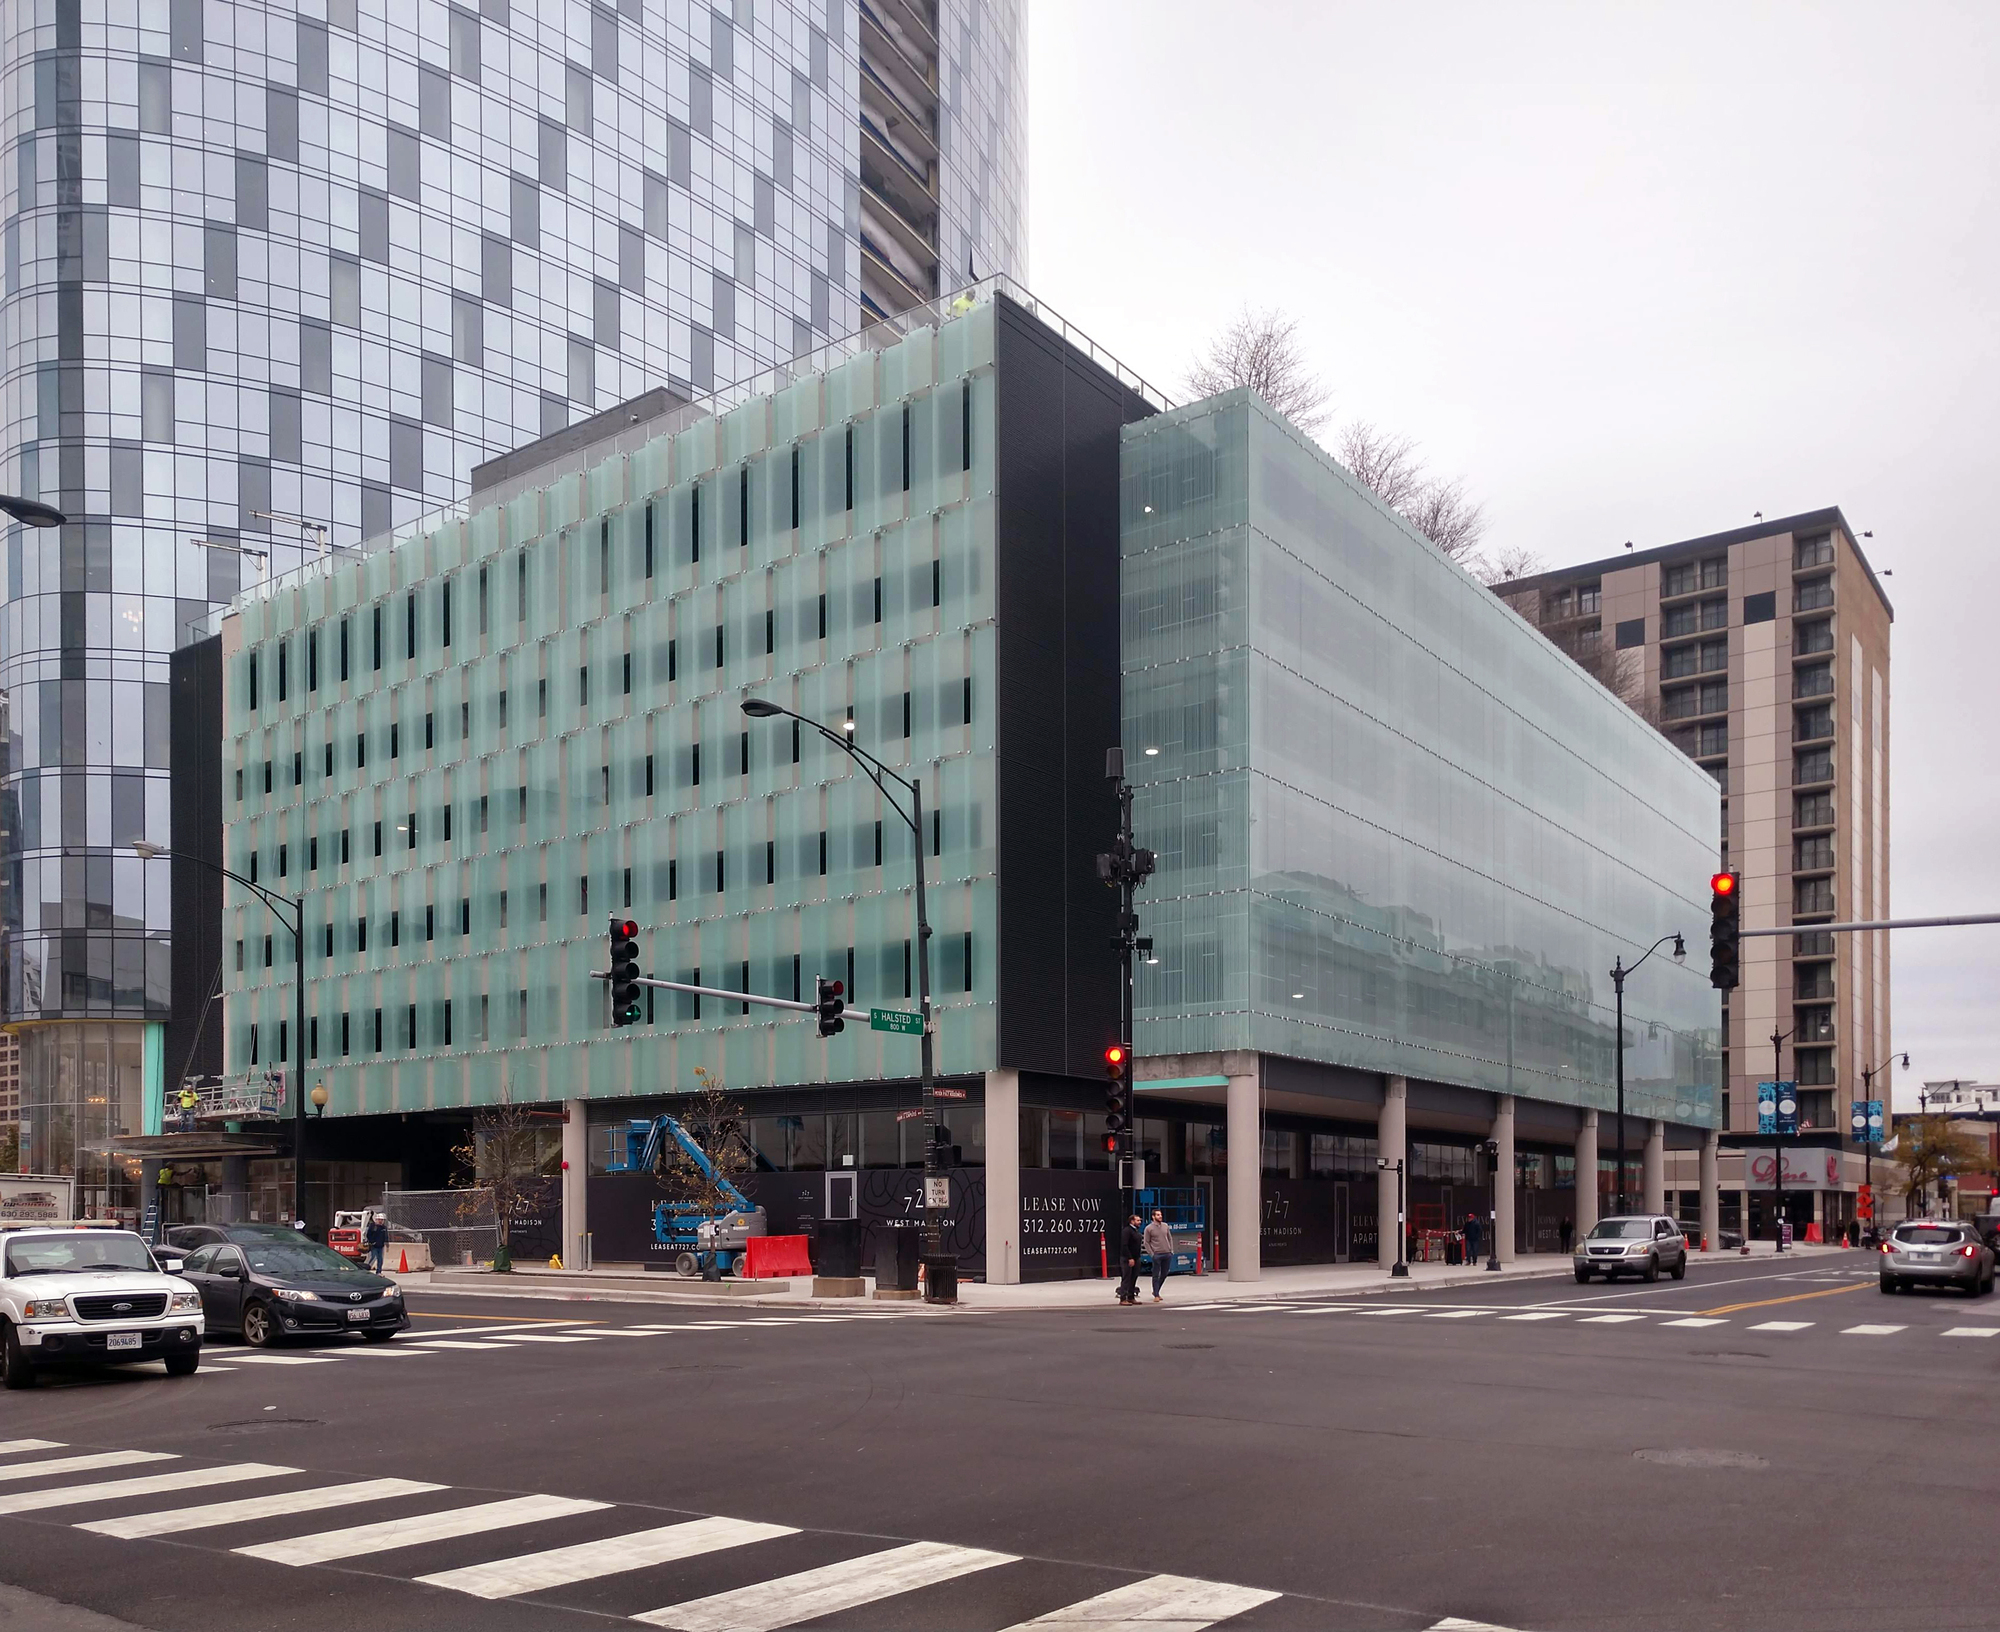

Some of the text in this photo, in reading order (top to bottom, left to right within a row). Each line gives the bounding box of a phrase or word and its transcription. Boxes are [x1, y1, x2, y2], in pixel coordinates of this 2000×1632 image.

[873, 1011, 878, 1019] S
[881, 1012, 912, 1024] HALSTED
[890, 1023, 900, 1031] 800
[903, 1188, 925, 1214] 72
[1023, 1197, 1102, 1212] LEASE NOW
[1266, 1191, 1290, 1219] 727
[1, 1210, 18, 1218] 630
[886, 1219, 955, 1227] WEST MAON
[1023, 1218, 1106, 1233] 312.260.3722
[1259, 1227, 1302, 1236] EST MADISON
[1352, 1233, 1378, 1245] APART
[650, 1243, 701, 1251] LEASEAT727.CO
[1023, 1247, 1078, 1255] LEASEAT727.COM
[108, 1337, 137, 1347] 2069485
